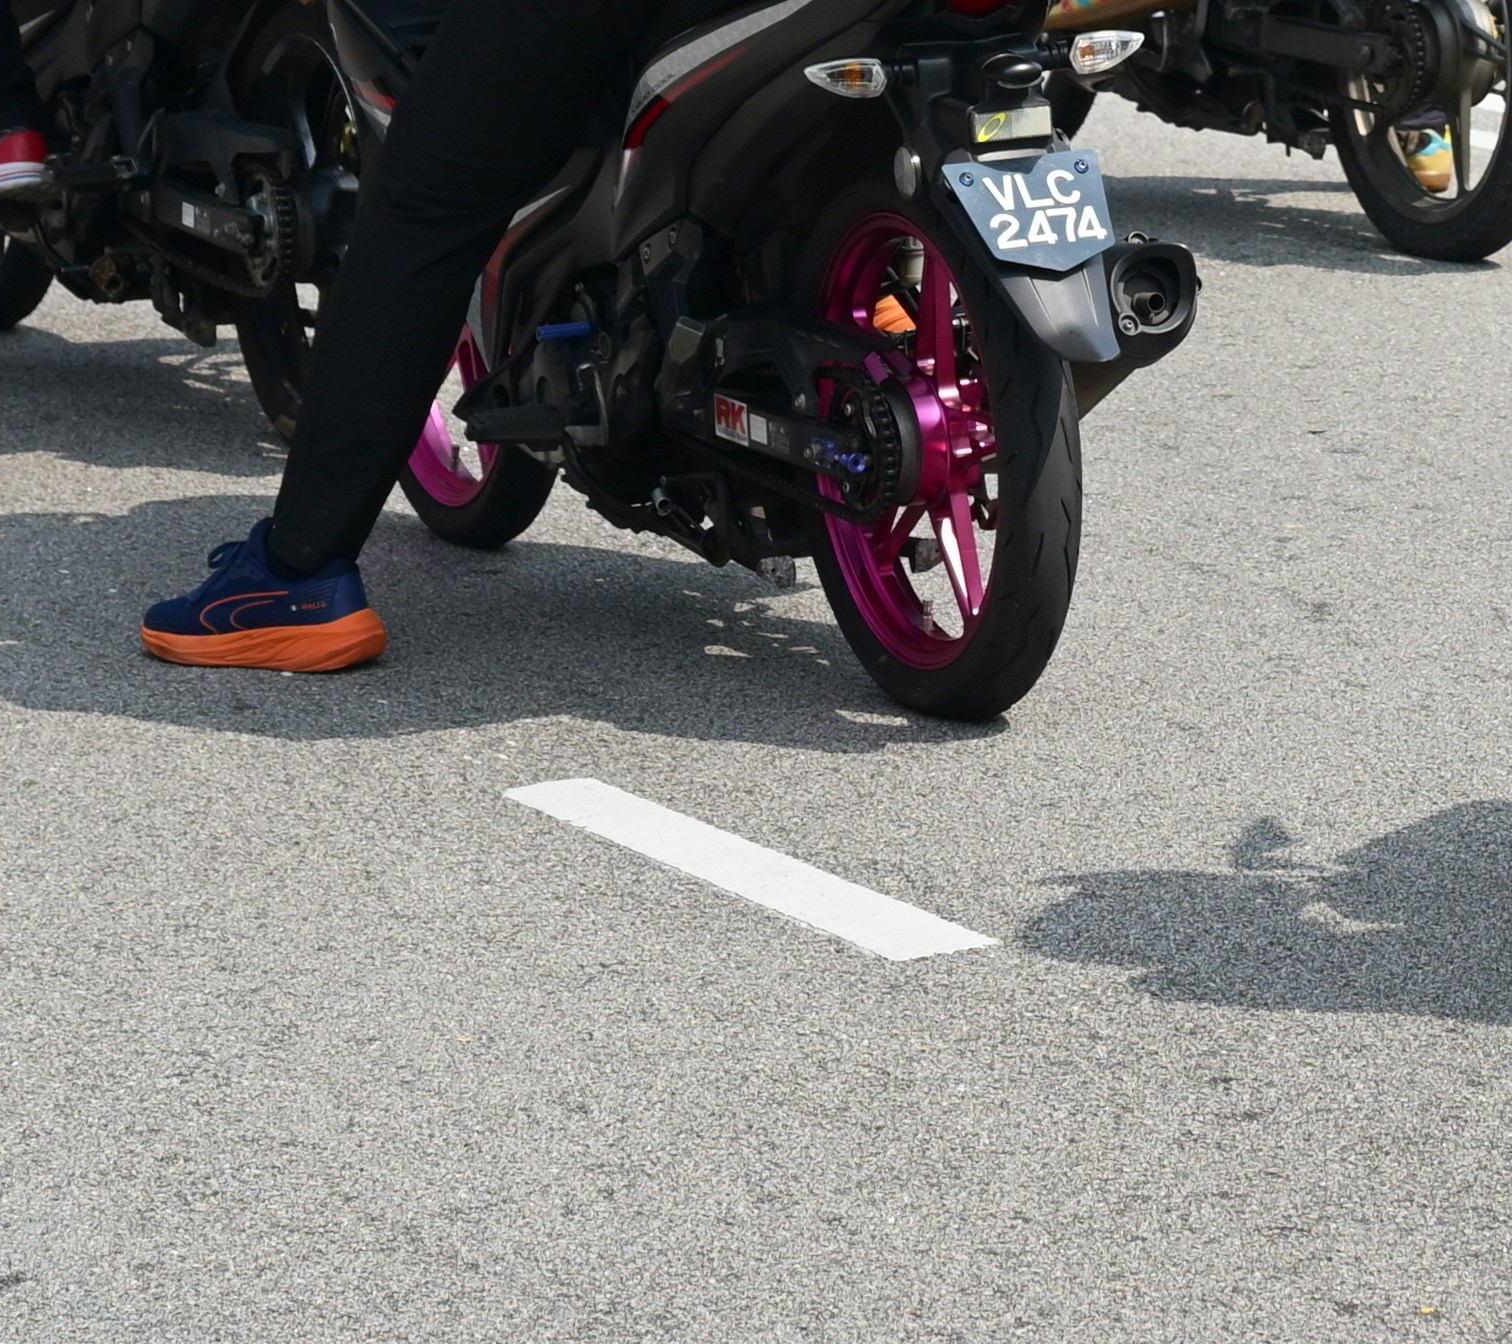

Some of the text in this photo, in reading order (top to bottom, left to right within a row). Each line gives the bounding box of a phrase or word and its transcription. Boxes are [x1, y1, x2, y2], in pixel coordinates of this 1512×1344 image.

[981, 168, 1082, 212] VLC
[989, 204, 1108, 251] 2474
[715, 395, 747, 436] RK
